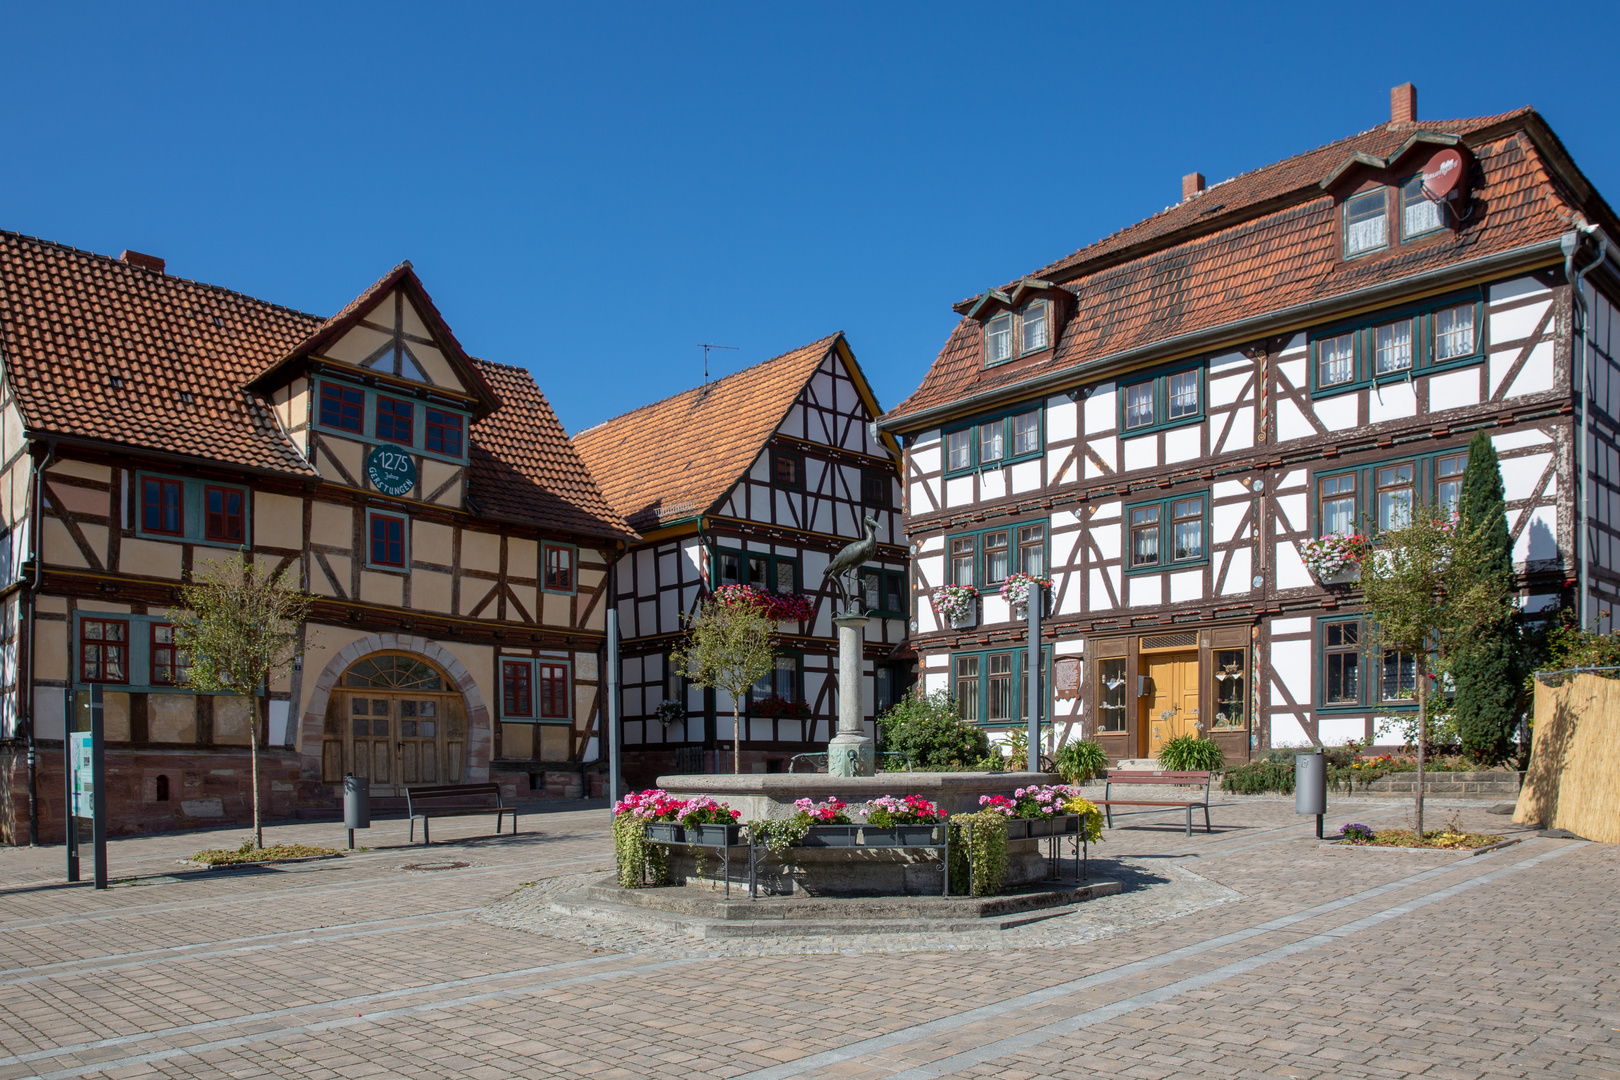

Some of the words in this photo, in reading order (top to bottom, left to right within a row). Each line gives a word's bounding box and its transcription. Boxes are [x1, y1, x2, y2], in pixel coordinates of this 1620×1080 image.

[378, 451, 408, 472] 1275
[368, 466, 413, 495] GERSTUNGEN
[384, 471, 399, 481] Jahre
